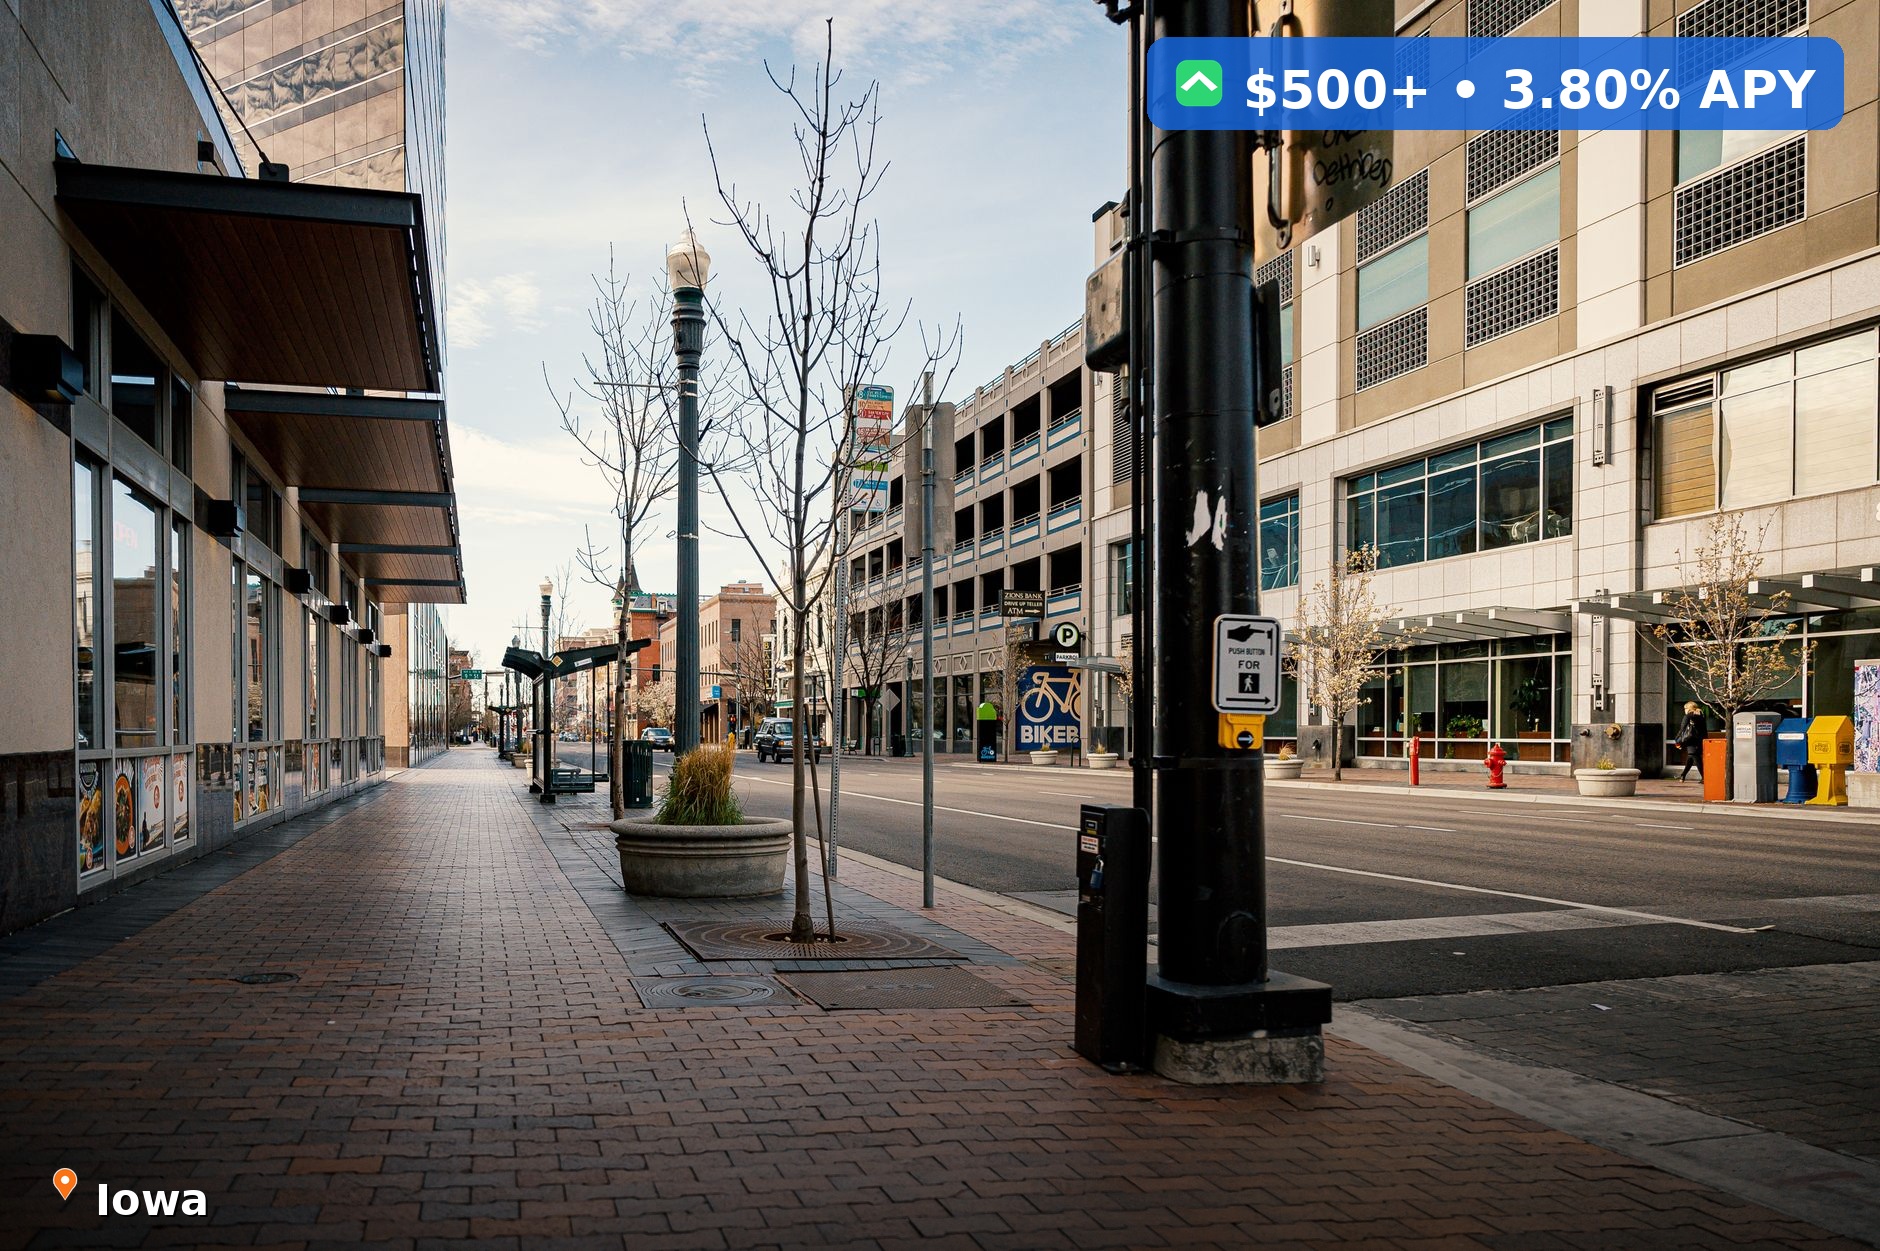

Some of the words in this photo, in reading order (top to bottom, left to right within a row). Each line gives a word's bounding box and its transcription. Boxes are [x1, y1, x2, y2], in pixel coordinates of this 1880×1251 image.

[1007, 607, 1024, 615] ATM
[1062, 628, 1073, 642] P
[1228, 647, 1245, 655] PUSH
[1246, 648, 1265, 656] BUTTON
[1238, 660, 1260, 669] FOR
